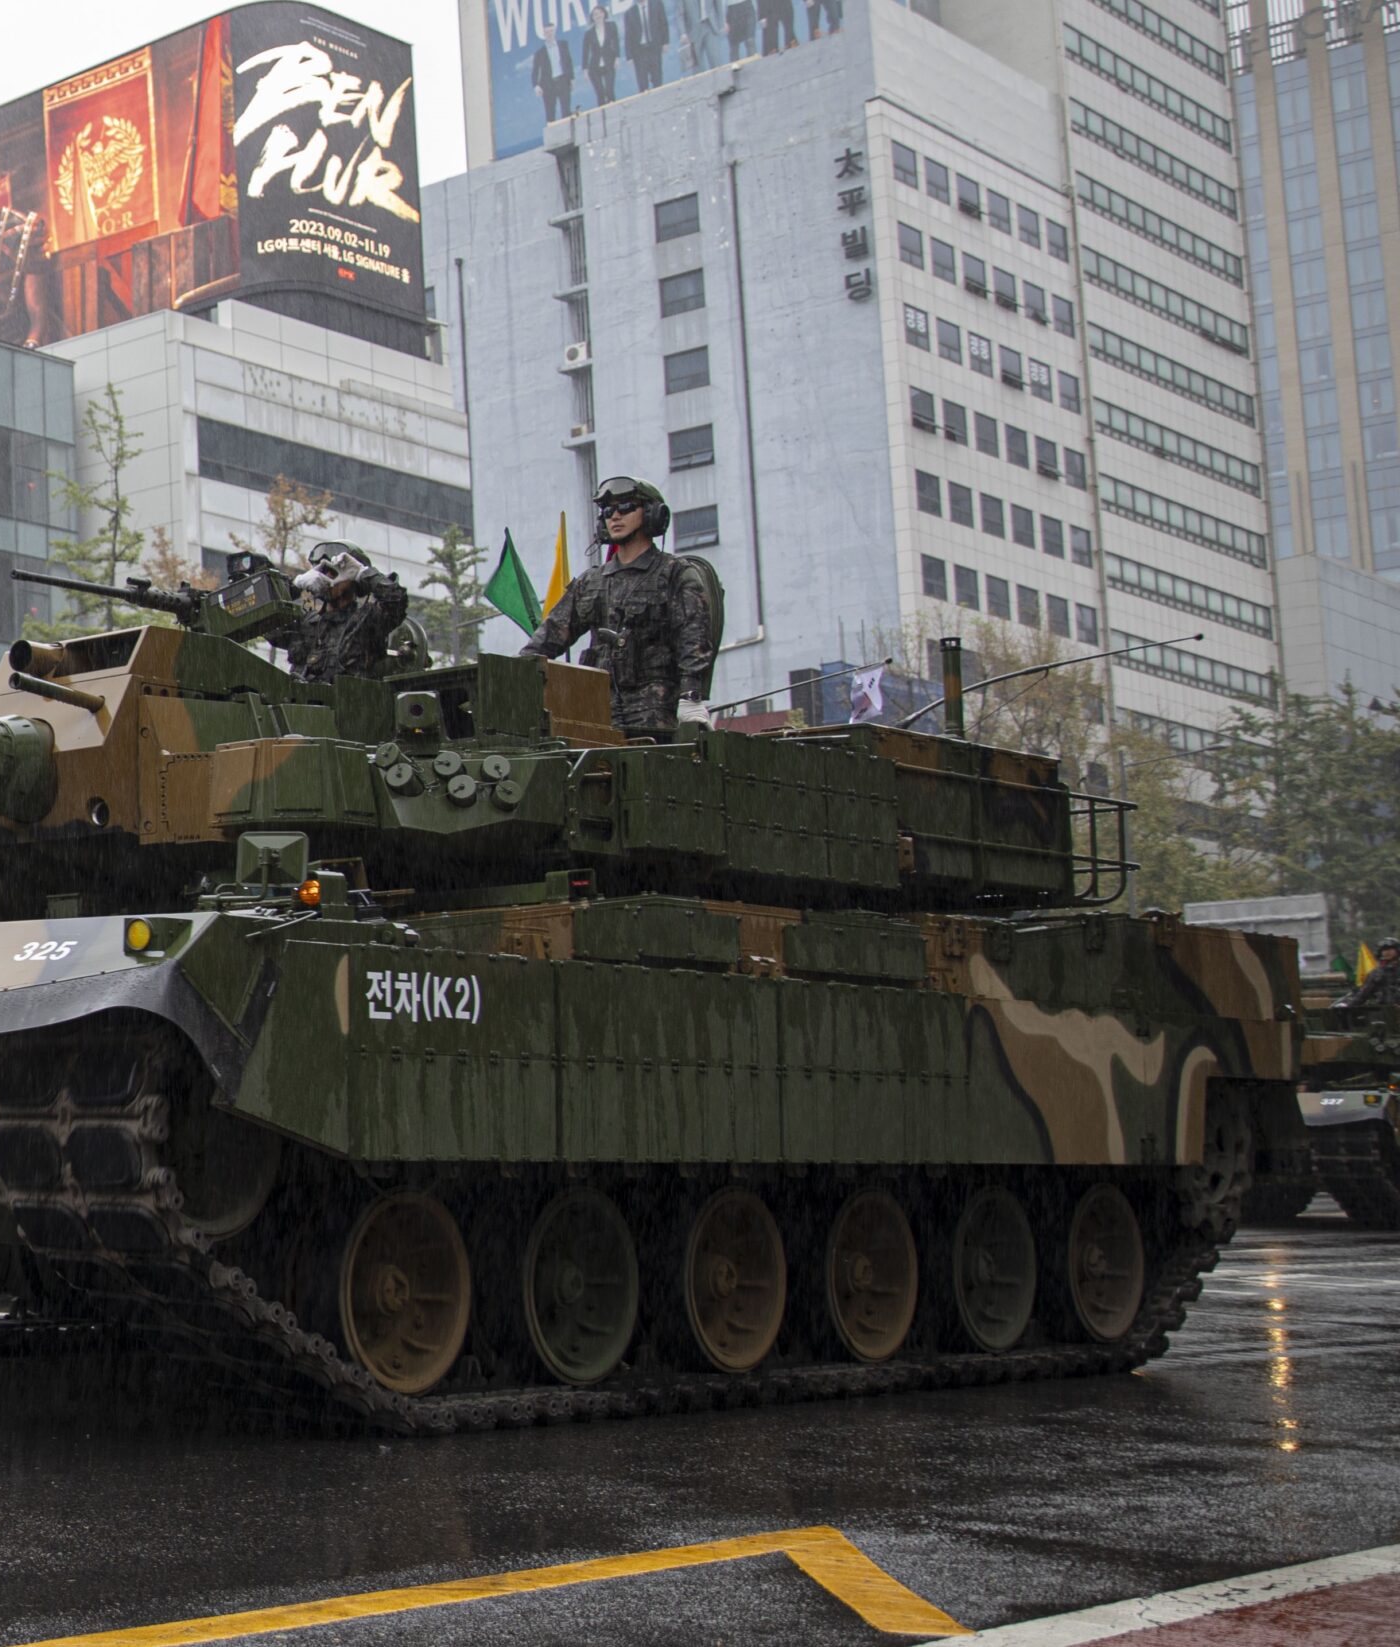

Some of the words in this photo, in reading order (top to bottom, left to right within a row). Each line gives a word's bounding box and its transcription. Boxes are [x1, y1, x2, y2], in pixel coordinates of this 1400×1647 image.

[233, 41, 412, 149] BEN
[247, 124, 420, 223] HUR
[257, 237, 322, 255] LG아트센터
[343, 250, 355, 265] LG
[355, 254, 401, 280] SIGNATURE
[13, 941, 78, 961] 325
[365, 970, 481, 1024] 전차(K2)
